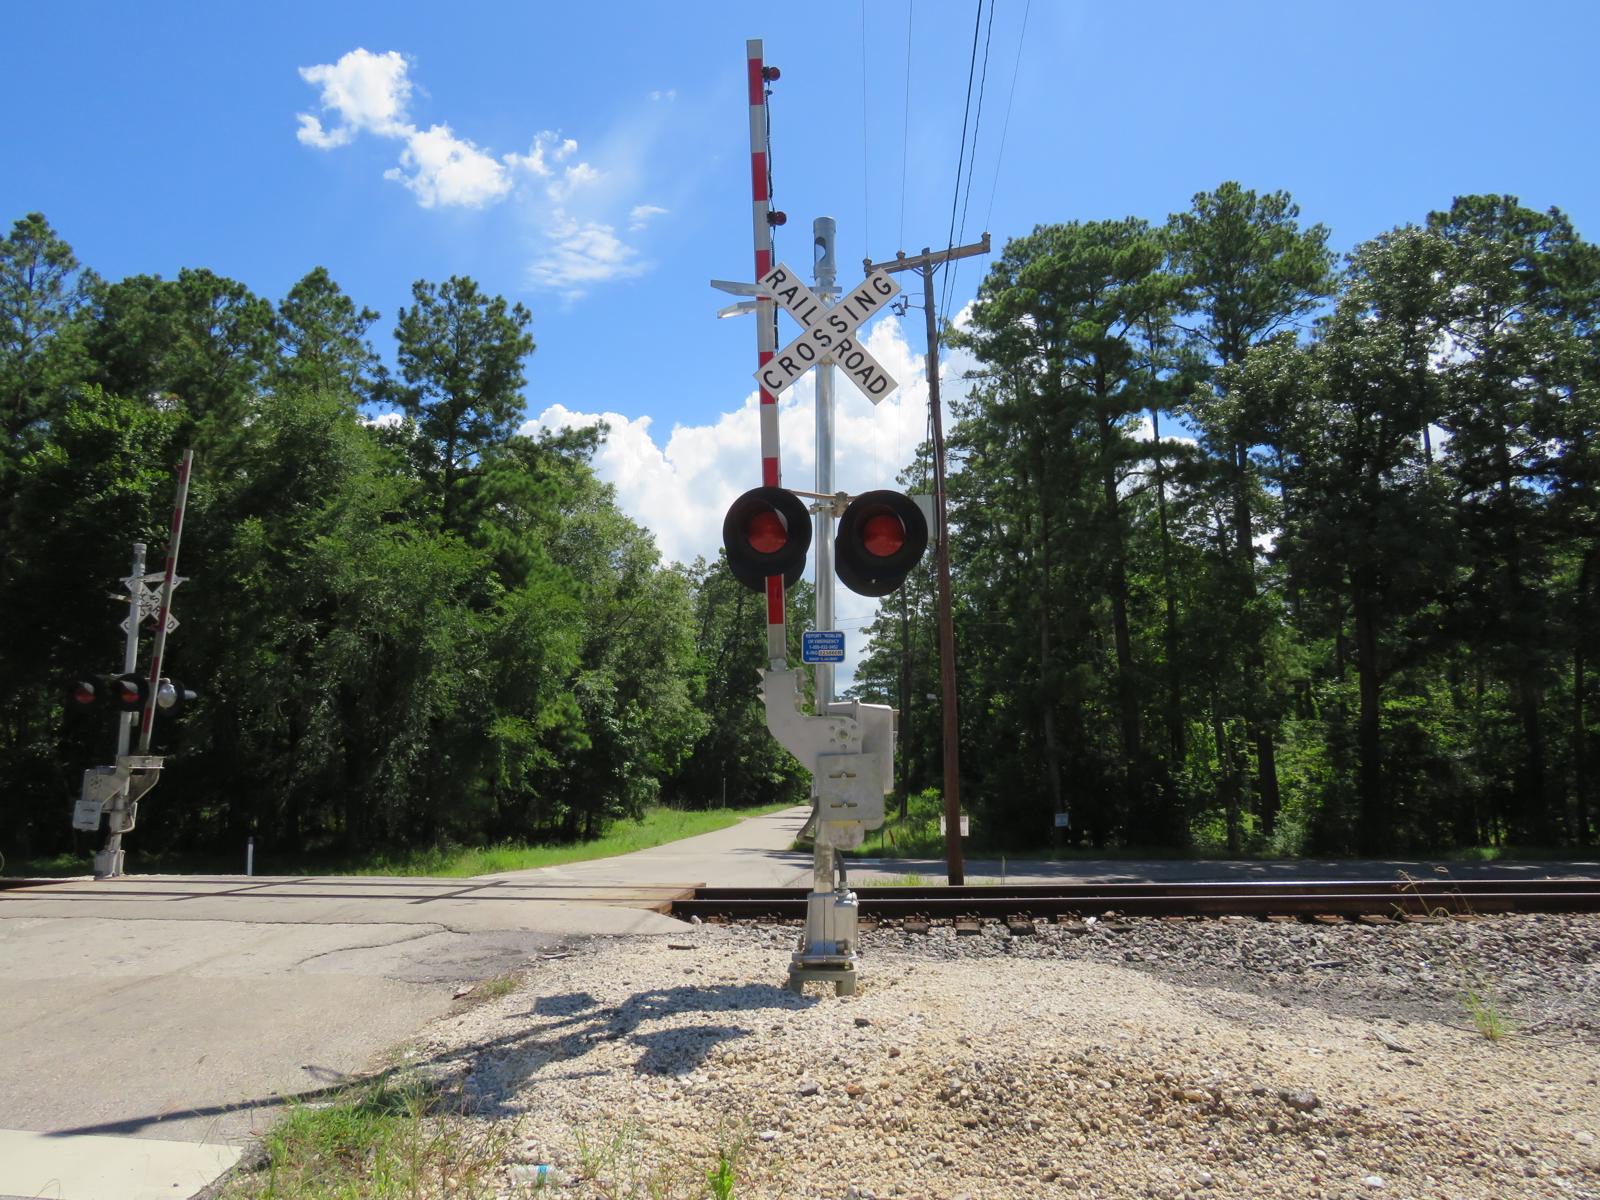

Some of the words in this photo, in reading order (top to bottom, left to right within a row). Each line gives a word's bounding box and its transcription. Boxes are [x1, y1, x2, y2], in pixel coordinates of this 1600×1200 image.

[763, 277, 892, 390] CROSSING
[765, 269, 817, 326] RAIL
[832, 338, 888, 394] ROAD
